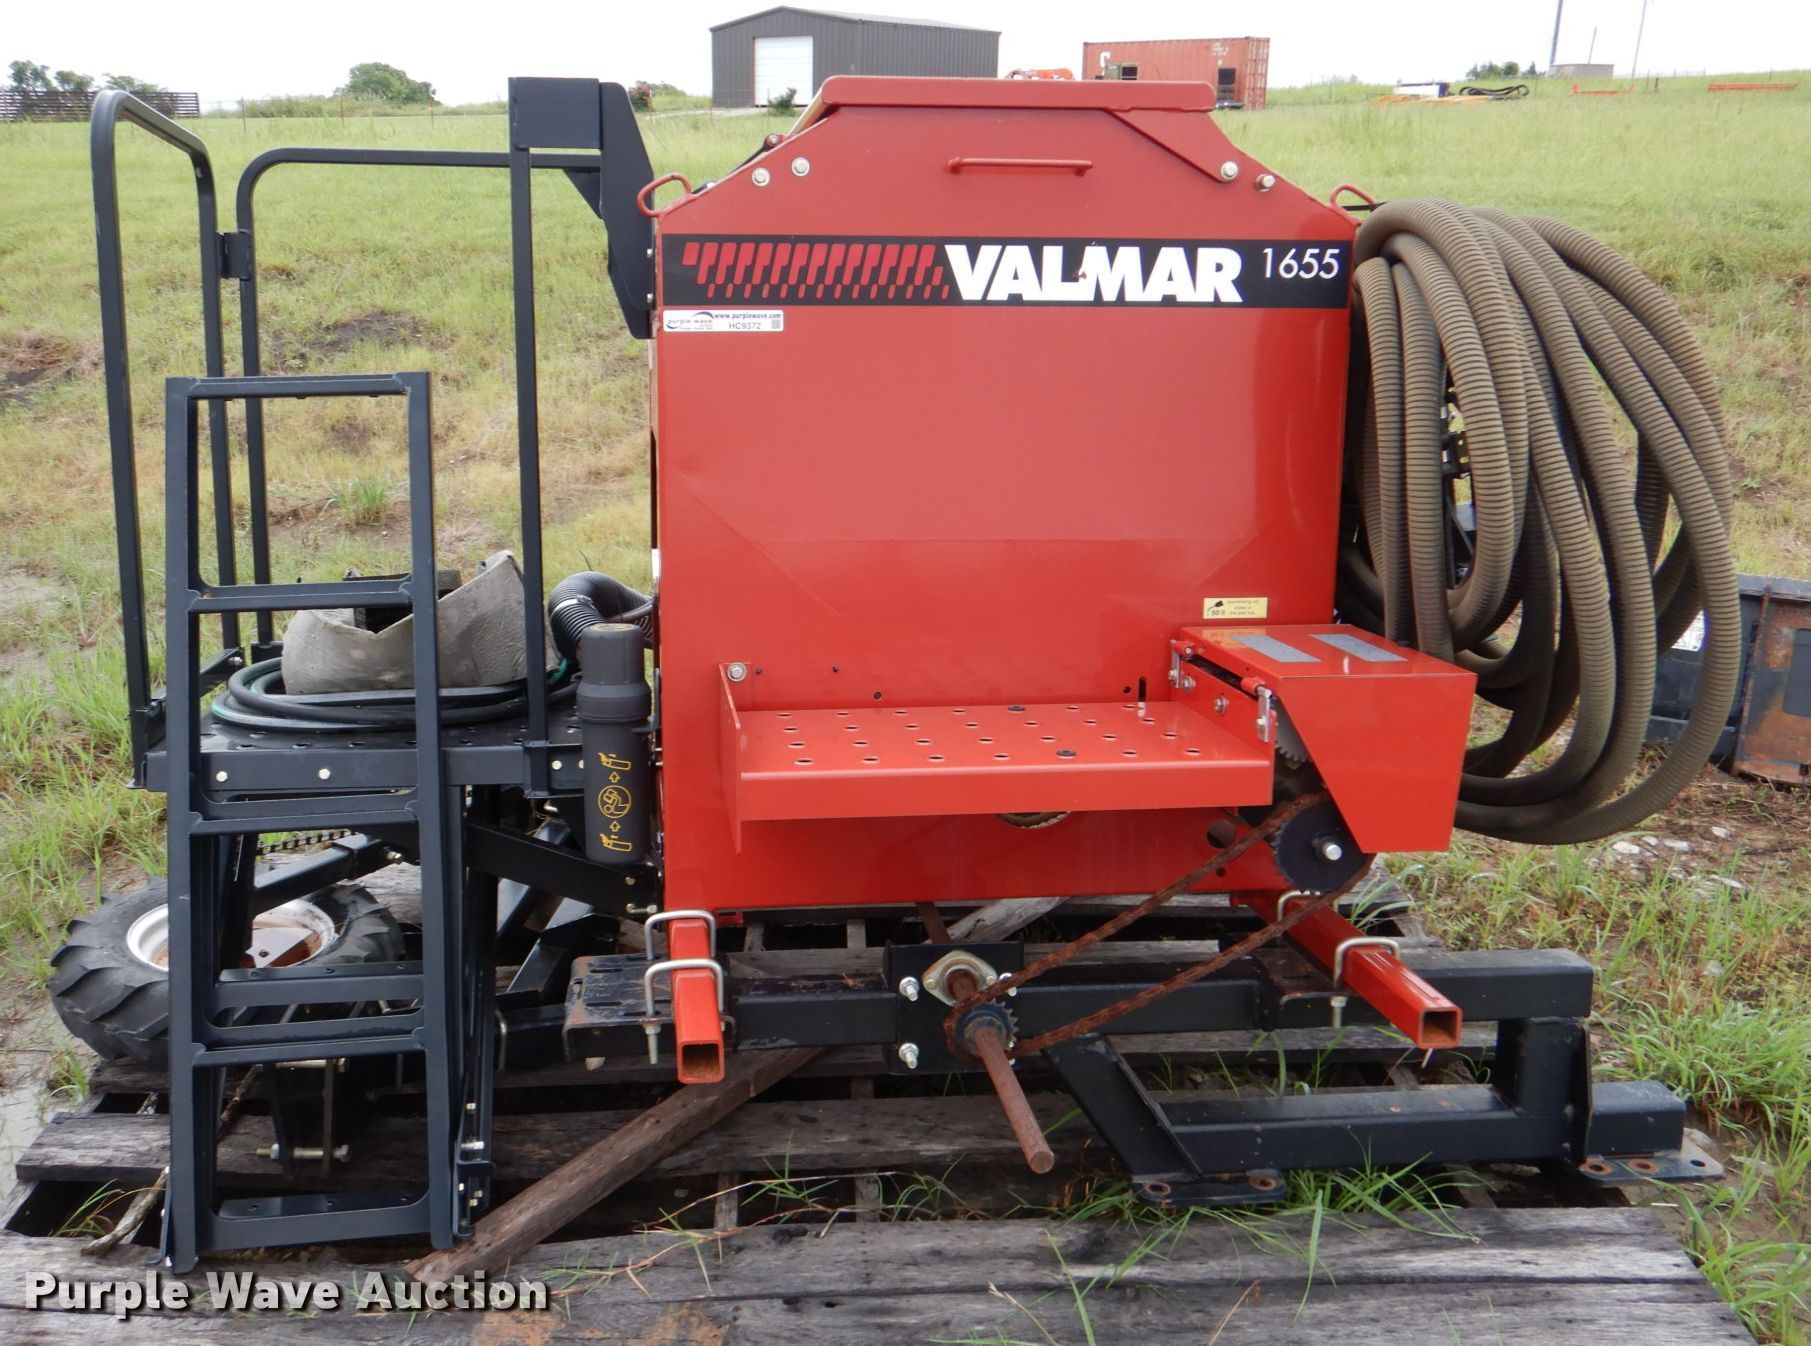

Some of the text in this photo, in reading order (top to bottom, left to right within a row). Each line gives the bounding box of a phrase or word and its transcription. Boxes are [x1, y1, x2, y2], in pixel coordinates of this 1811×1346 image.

[944, 244, 1340, 303] VALMAR 1655
[728, 322, 761, 330] HC9372
